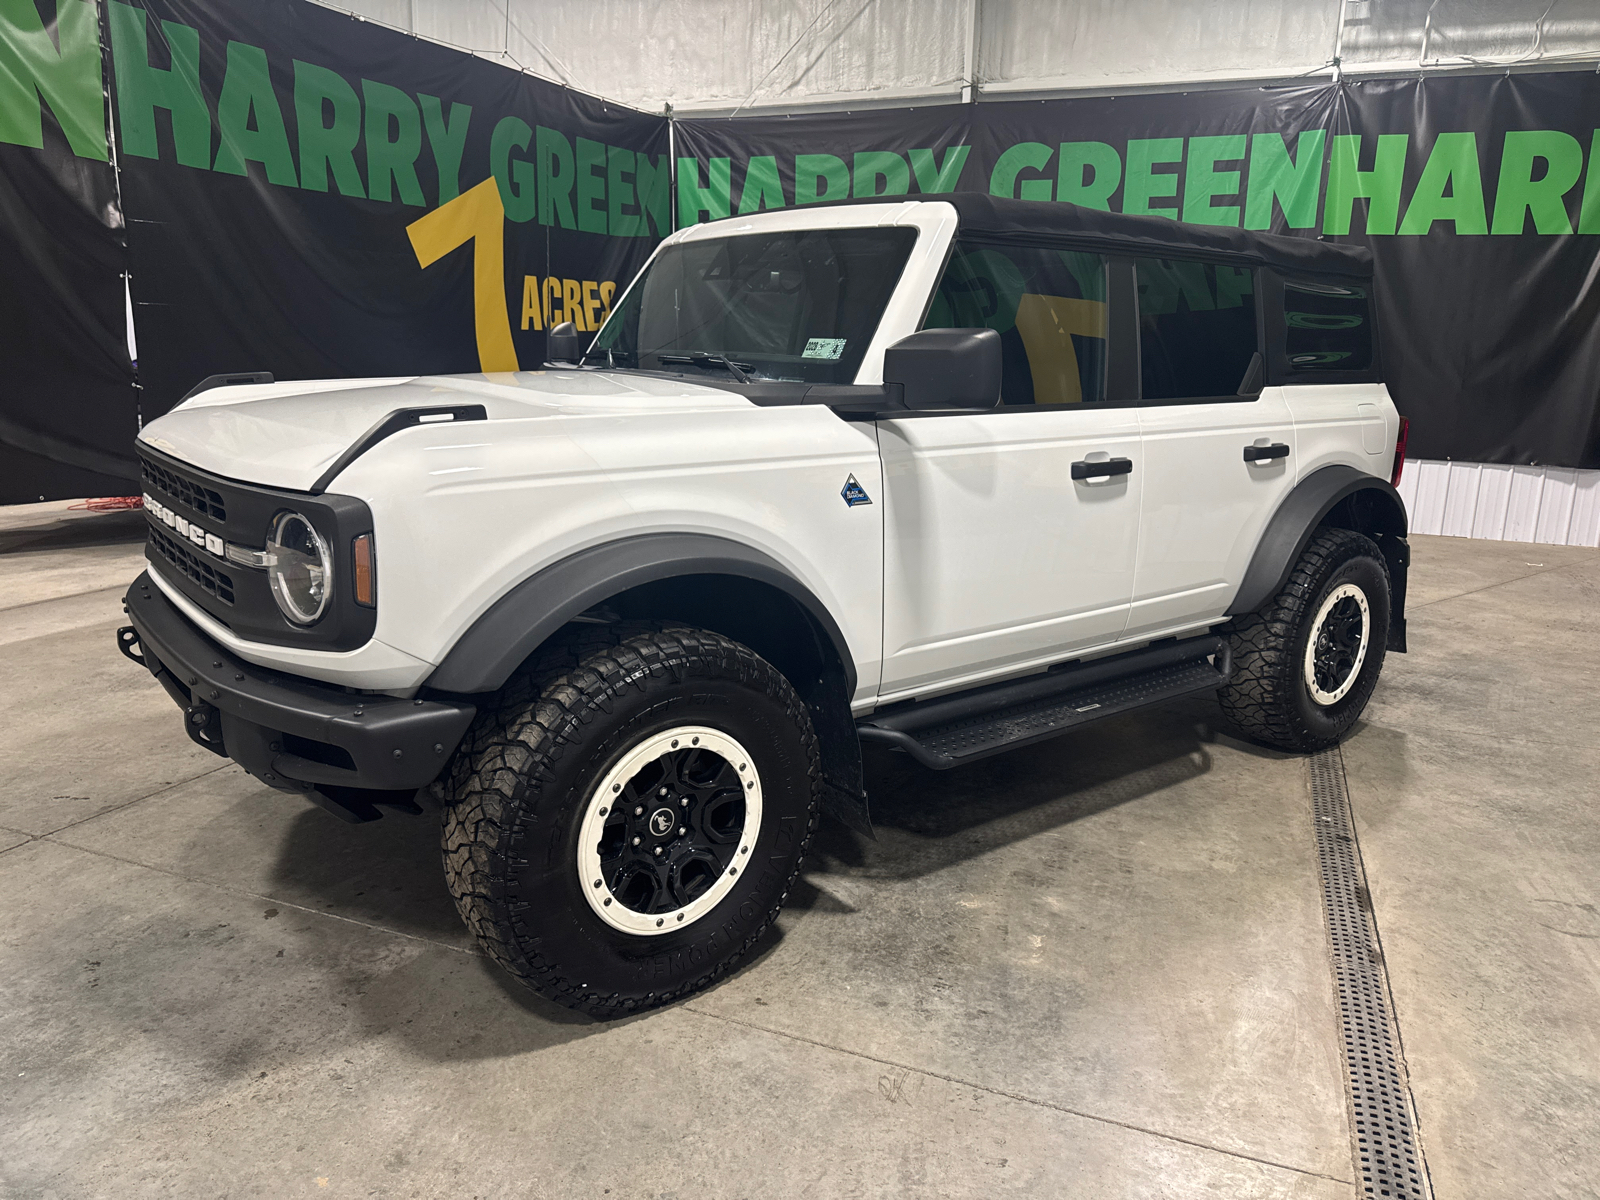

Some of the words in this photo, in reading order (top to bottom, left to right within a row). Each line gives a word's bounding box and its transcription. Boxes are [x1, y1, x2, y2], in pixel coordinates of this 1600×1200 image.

[107, 0, 472, 208] HARRY
[490, 116, 668, 237] GREEN
[989, 129, 1327, 229] GREEN
[1322, 128, 1600, 235] HAR
[405, 175, 520, 372] 7
[521, 275, 617, 332] ACRES
[143, 492, 224, 556] BRONCO
